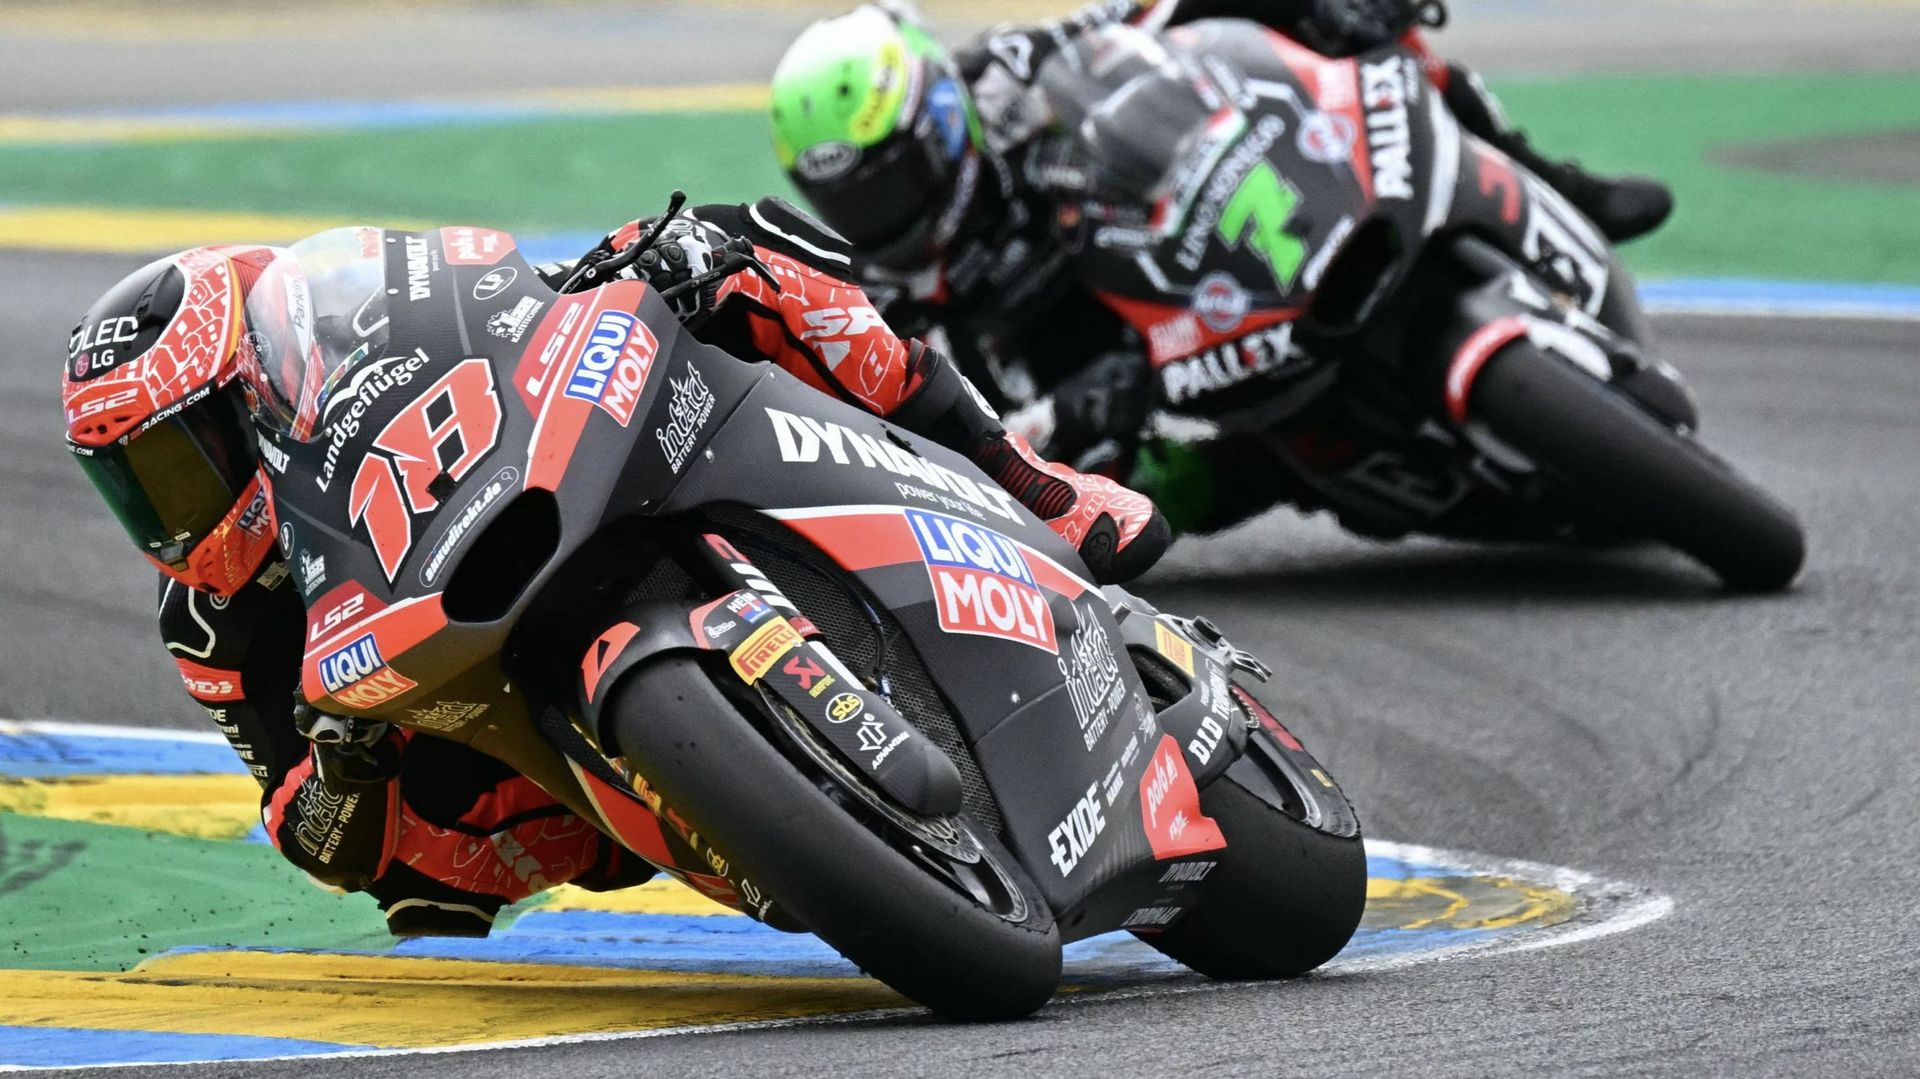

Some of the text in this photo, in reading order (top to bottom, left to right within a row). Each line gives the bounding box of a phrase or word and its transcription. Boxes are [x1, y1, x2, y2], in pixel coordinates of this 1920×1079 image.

[1217, 159, 1304, 297] 7
[405, 236, 431, 301] DYNAVOLT
[92, 349, 115, 369] LG
[525, 302, 584, 397] LS2
[569, 314, 632, 399] LIQUI
[603, 325, 655, 419] MOLY
[68, 388, 139, 424] LS2
[316, 347, 430, 493] Landgeflügel
[671, 392, 716, 475] BATTERY POWER
[765, 407, 1026, 526] DYNAVOLT
[913, 513, 1032, 585] LIQUI
[310, 593, 364, 642] LS2
[938, 571, 1050, 645] MOLY
[320, 636, 382, 692] LIQUI
[736, 623, 797, 678] PIRELLI
[337, 669, 406, 706] MOLY
[832, 695, 861, 720] sbs
[1083, 677, 1127, 752] BATTERY POWER
[1188, 716, 1223, 766] D.I.D
[318, 826, 344, 864] BATTERY
[1047, 782, 1106, 878] EXIDE
